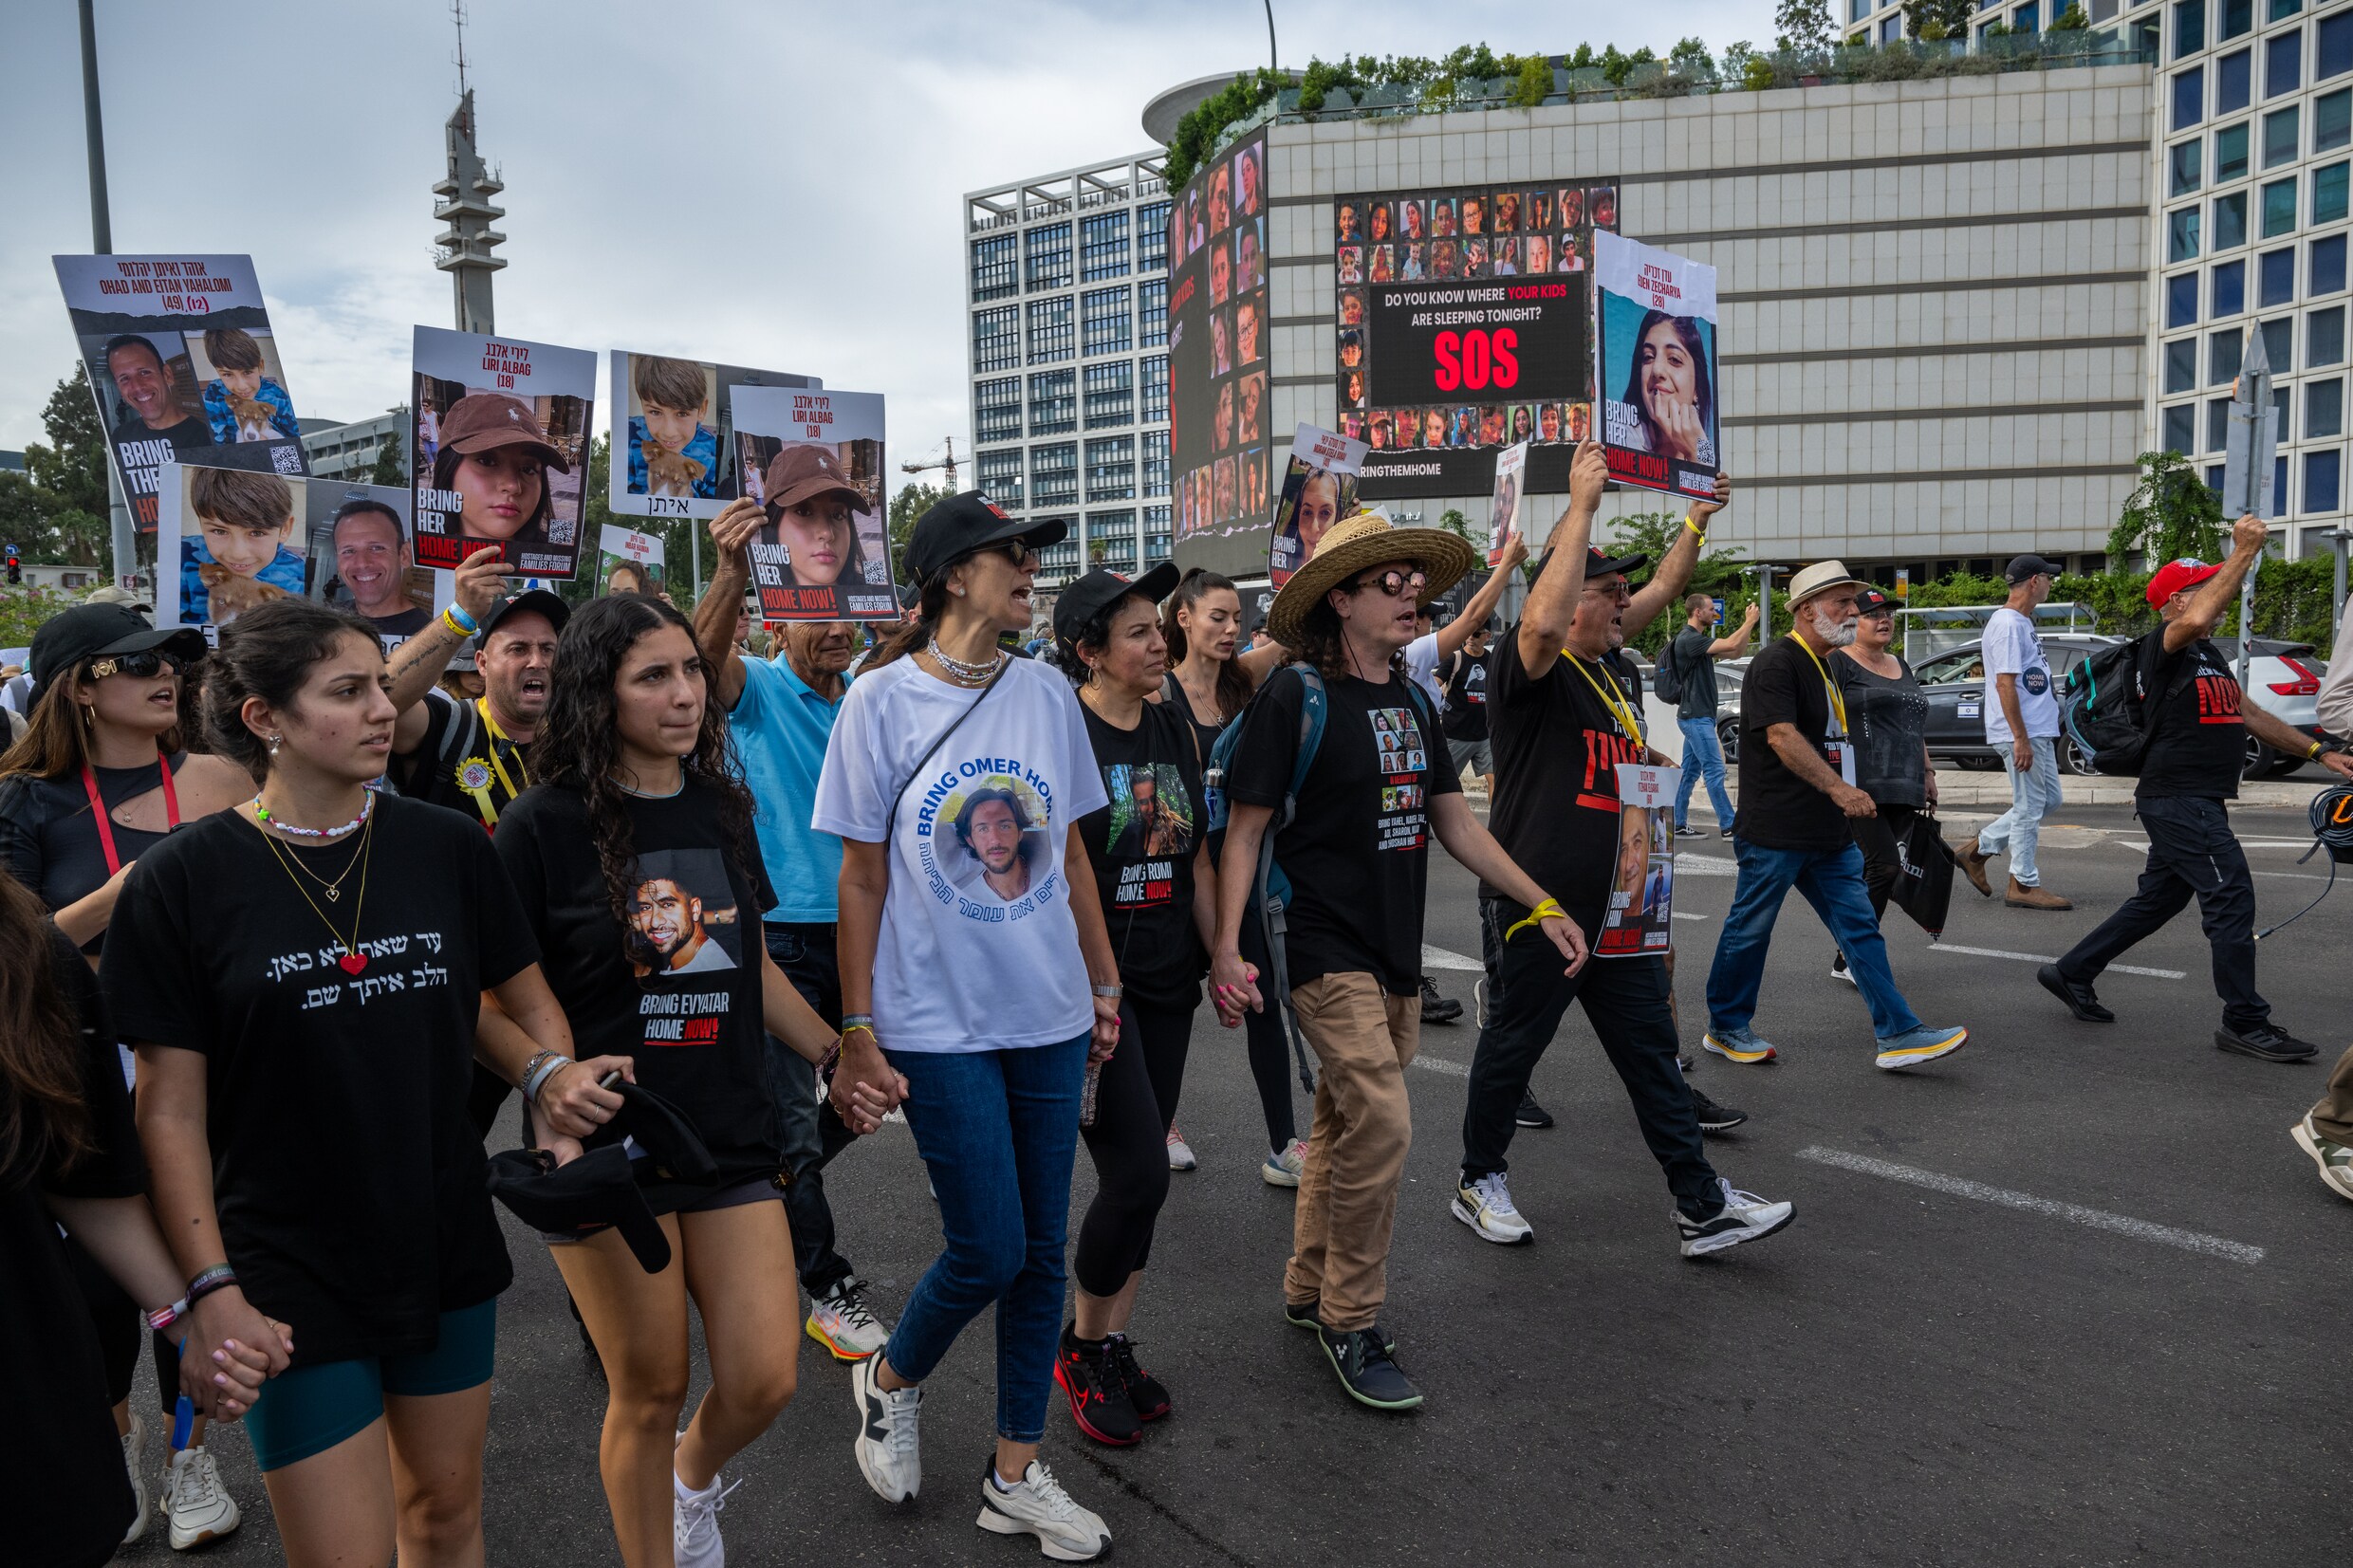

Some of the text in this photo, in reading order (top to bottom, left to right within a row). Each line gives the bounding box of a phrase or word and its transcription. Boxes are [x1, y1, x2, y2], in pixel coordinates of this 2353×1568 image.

[117, 261, 208, 278] אוהד ואיתן יהלומי
[1661, 268, 1672, 283] עדן
[99, 278, 233, 295] OHAD AND EITAN YAHALOMI
[1385, 284, 1566, 306] DO YOU KNOW WHERE YOUR KIDS
[1638, 273, 1681, 300] EDEN ZECHARYA
[1652, 293, 1665, 309] (28)
[1411, 306, 1542, 326] ARE SLEEPING TONIGHT?
[486, 342, 529, 361] לירי אלבג
[1434, 327, 1519, 392] SOS
[482, 358, 531, 377] LIRI ALBAG
[496, 373, 514, 390] (18)
[793, 396, 830, 409] לירי אלבג
[1605, 398, 1639, 427] BRING
[792, 411, 833, 424] LIRI ALBAG
[806, 425, 821, 439] (18)
[1605, 422, 1627, 447] HER
[119, 438, 176, 468] BRING
[1359, 463, 1441, 478] RINGTHEMHOME
[1606, 447, 1669, 481] HOME NOW!
[126, 468, 159, 494] THE
[1679, 476, 1714, 493] FAMILIES FORU
[136, 497, 159, 524] HO
[417, 488, 463, 514] BRING
[648, 498, 689, 515] איתן
[417, 510, 446, 535] HER
[417, 536, 458, 561] HOME
[751, 544, 791, 564] BRING
[1272, 534, 1296, 554] BRING
[520, 559, 571, 572] FAMILIES FORUM
[1271, 551, 1287, 569] HER
[756, 564, 783, 585] HER
[1272, 569, 1294, 585] HOM
[761, 586, 837, 609] HOME NOW!
[849, 601, 894, 612] FAMILIES FORUM
[917, 757, 1053, 837] BRING OMER HOM
[1378, 818, 1391, 829] BRING
[1378, 840, 1388, 851] AND
[918, 841, 954, 905] הביתה
[1147, 861, 1173, 880] ROMI
[1116, 880, 1172, 902] HOME NOW!
[1611, 891, 1631, 909] BRING
[958, 896, 1005, 923] עומר
[1010, 897, 1035, 921] את
[1606, 910, 1622, 928] HIM
[358, 934, 409, 959] שאת
[416, 932, 442, 954] עד
[1602, 929, 1624, 947] HOME
[1623, 925, 1642, 947] NOW!
[266, 951, 313, 983] כאן.
[301, 961, 448, 1010] הלב איתך שם.
[639, 991, 730, 1015] BRING EVYATAR
[644, 1017, 719, 1040] HOME NOW!
